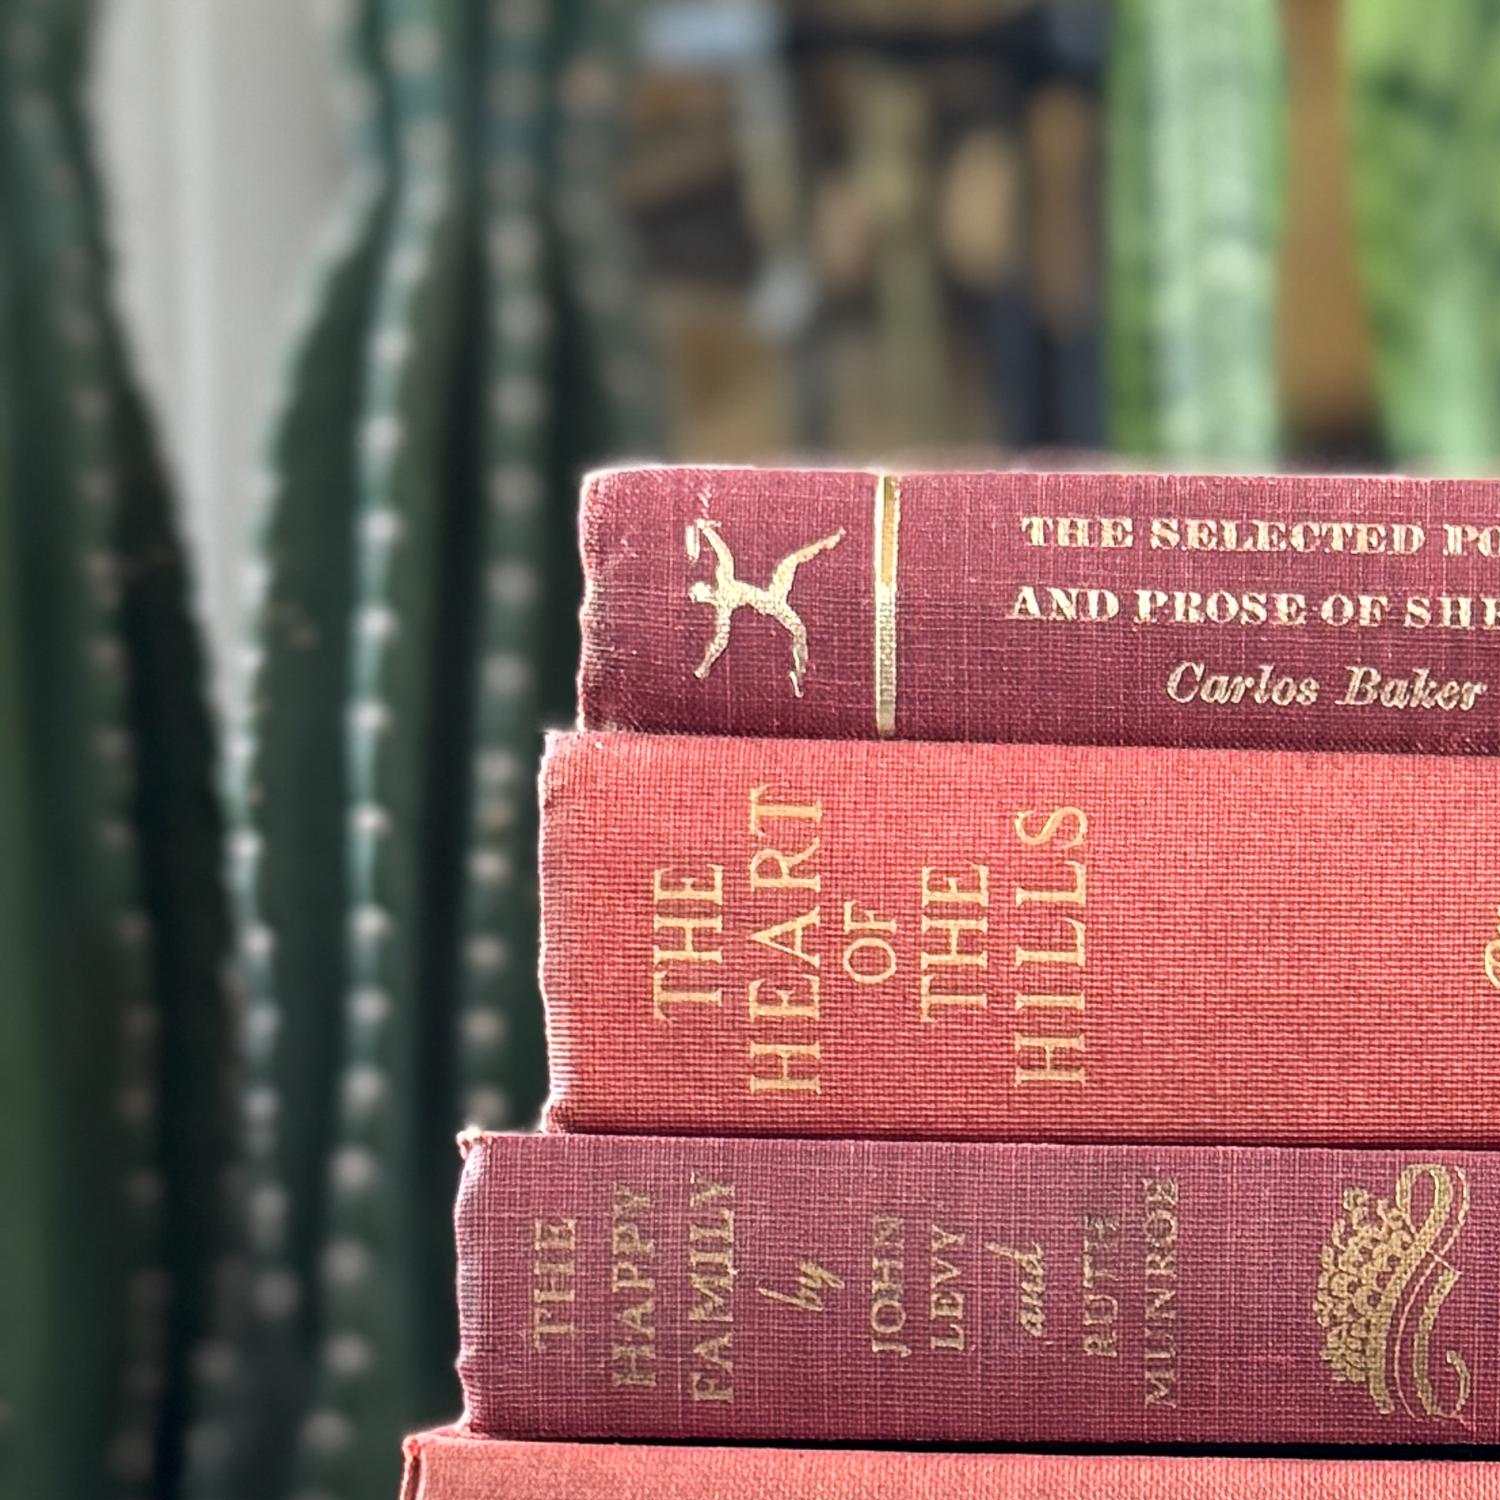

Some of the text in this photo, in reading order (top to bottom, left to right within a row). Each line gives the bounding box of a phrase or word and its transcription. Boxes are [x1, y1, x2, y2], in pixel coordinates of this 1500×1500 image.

[1012, 585, 1118, 621] AND
[1133, 589, 1307, 627] PROSE
[1320, 594, 1390, 627] OF
[1021, 516, 1133, 548] THE
[1149, 517, 1426, 554] SELECTED
[1166, 661, 1487, 712] Carlos Baker
[653, 863, 723, 1024] THE
[748, 781, 823, 1094] HEART
[843, 899, 897, 985] OF
[920, 860, 989, 1023] THE
[1015, 806, 1088, 1088] HILLS
[533, 1218, 577, 1352] THE
[611, 1181, 656, 1387] HAPPY
[689, 1171, 735, 1403] FAMILY
[756, 1260, 845, 1312] by
[871, 1214, 912, 1357] JOHN
[931, 1225, 965, 1351] LEVY
[985, 1242, 1045, 1336] and
[1083, 1213, 1120, 1357] RUTH
[1143, 1177, 1179, 1409] MUNROE
